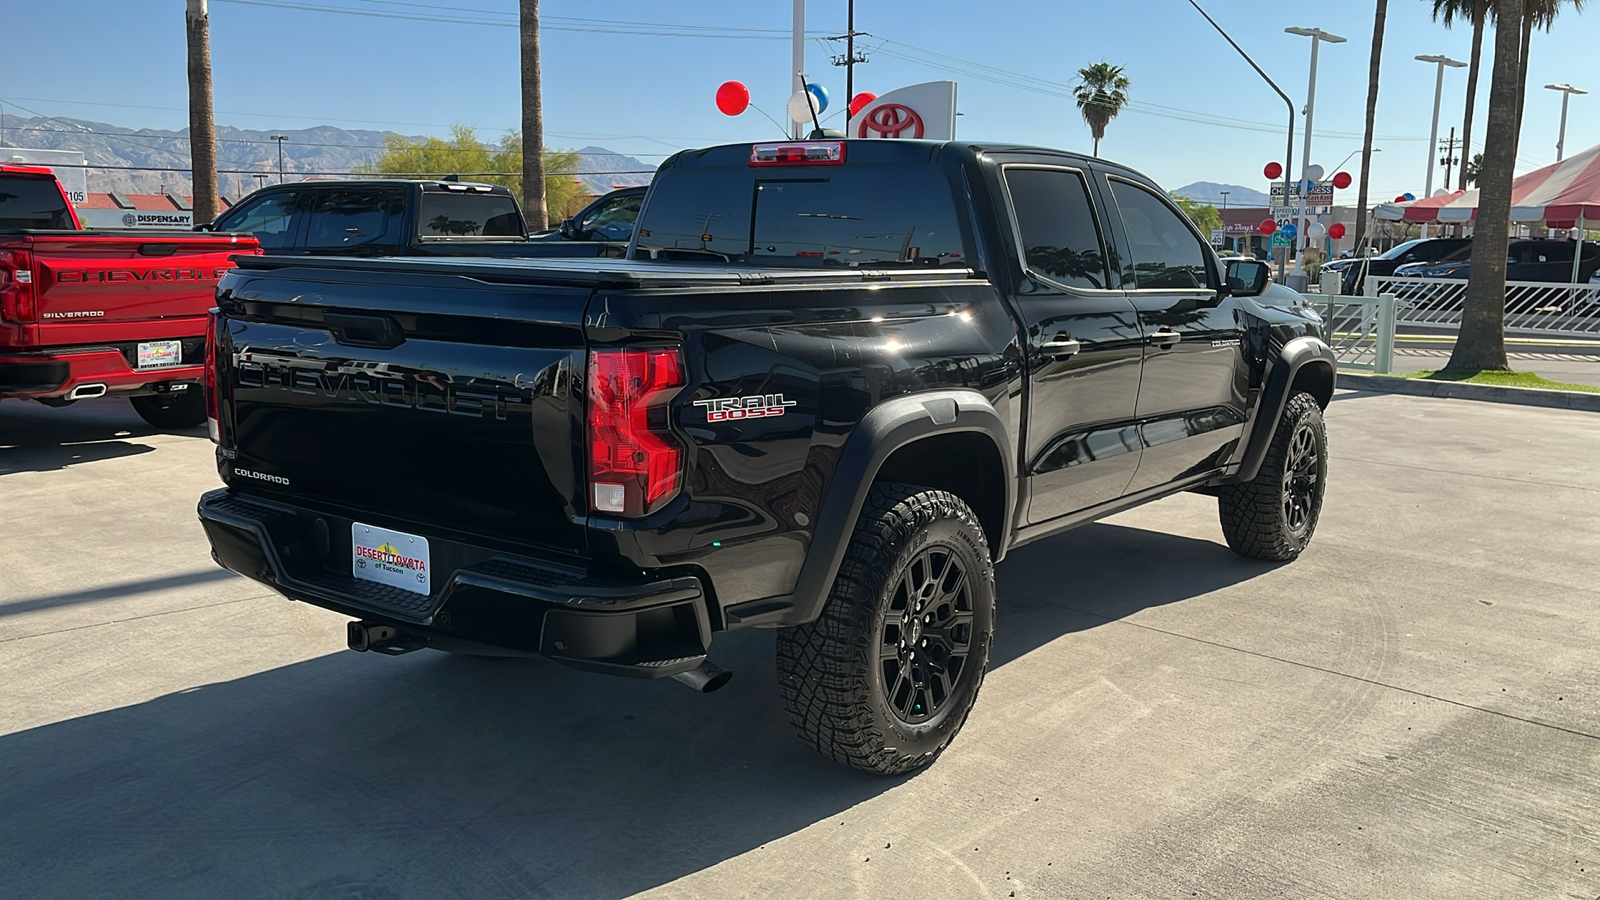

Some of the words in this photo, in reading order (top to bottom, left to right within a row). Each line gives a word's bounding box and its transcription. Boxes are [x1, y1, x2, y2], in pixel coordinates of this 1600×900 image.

[137, 214, 191, 223] DISPENSARY
[1276, 219, 1291, 229] 40
[1234, 223, 1254, 232] Boys
[57, 268, 225, 283] CHEVROLE
[43, 311, 105, 319] SILVERADO
[238, 360, 522, 421] CHEVROLET
[693, 393, 797, 412] TRAIL
[707, 405, 785, 422] BOSS
[234, 467, 290, 485] COLORADO
[356, 546, 388, 563] DESERT
[390, 553, 426, 572] TOYOTA
[382, 564, 404, 575] Tucson
